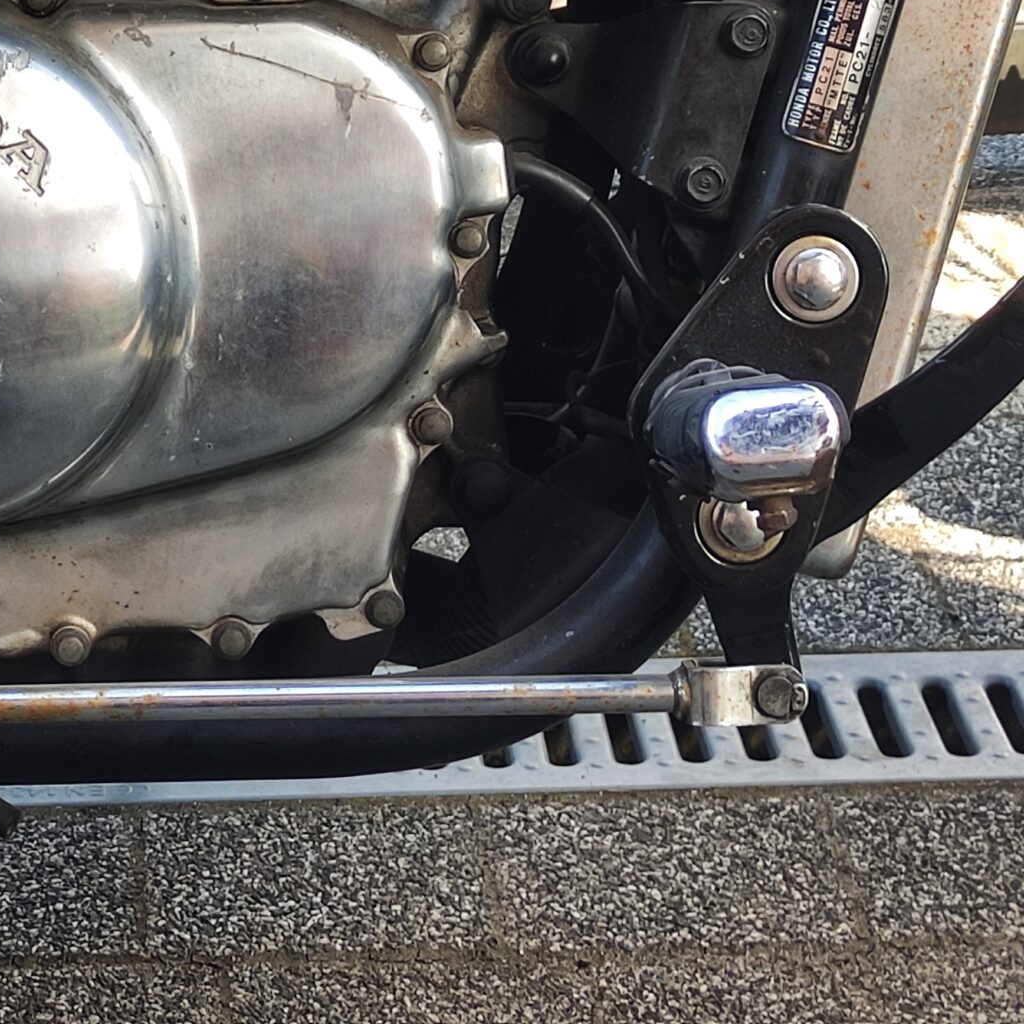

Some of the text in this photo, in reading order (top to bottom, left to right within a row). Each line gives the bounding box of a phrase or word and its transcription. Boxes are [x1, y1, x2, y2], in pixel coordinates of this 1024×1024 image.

[788, 86, 809, 126] HONDA
[802, 41, 822, 81] MOTOR
[815, 56, 833, 94] PC21
